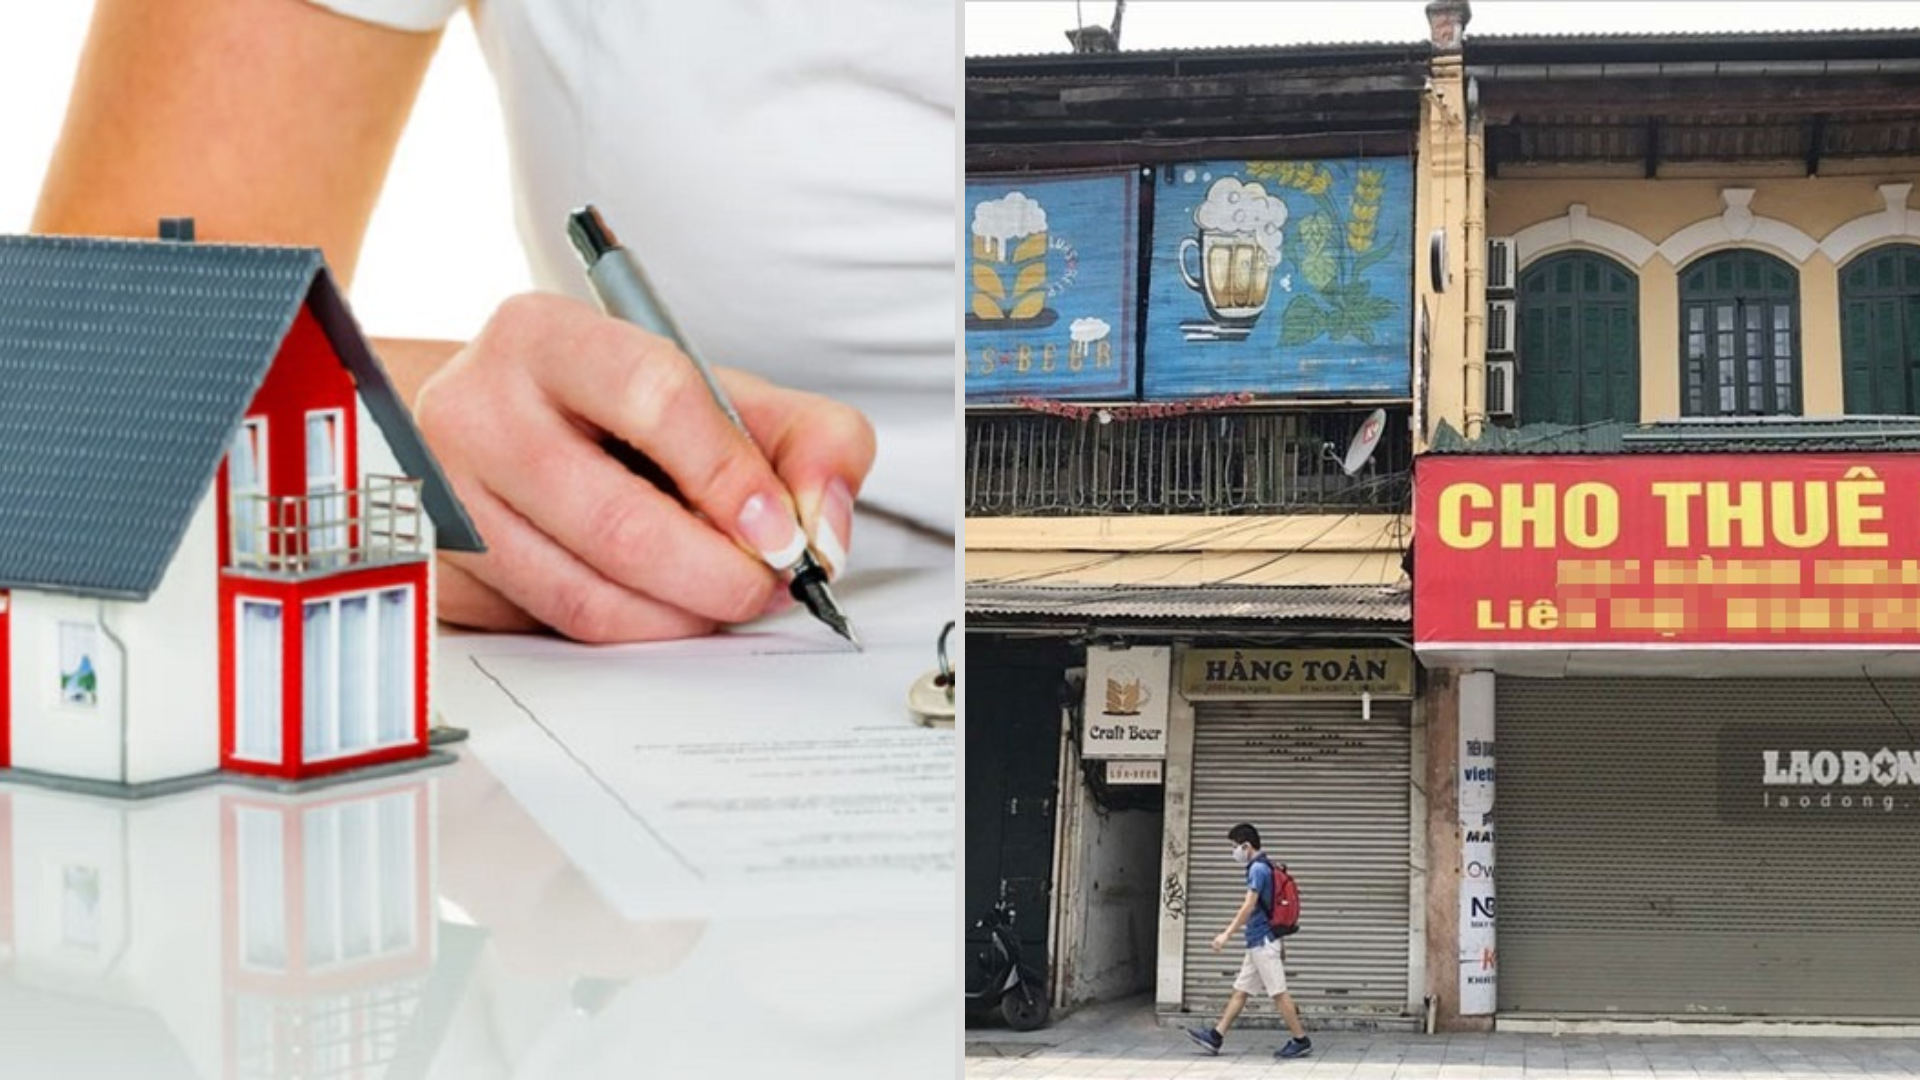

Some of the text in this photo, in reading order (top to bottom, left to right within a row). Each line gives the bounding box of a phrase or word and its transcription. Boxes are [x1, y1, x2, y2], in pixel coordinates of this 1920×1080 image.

[1438, 466, 1889, 549] CHO THUÊ
[1477, 599, 1590, 630] Liê
[1089, 726, 1162, 741] Craft Beer
